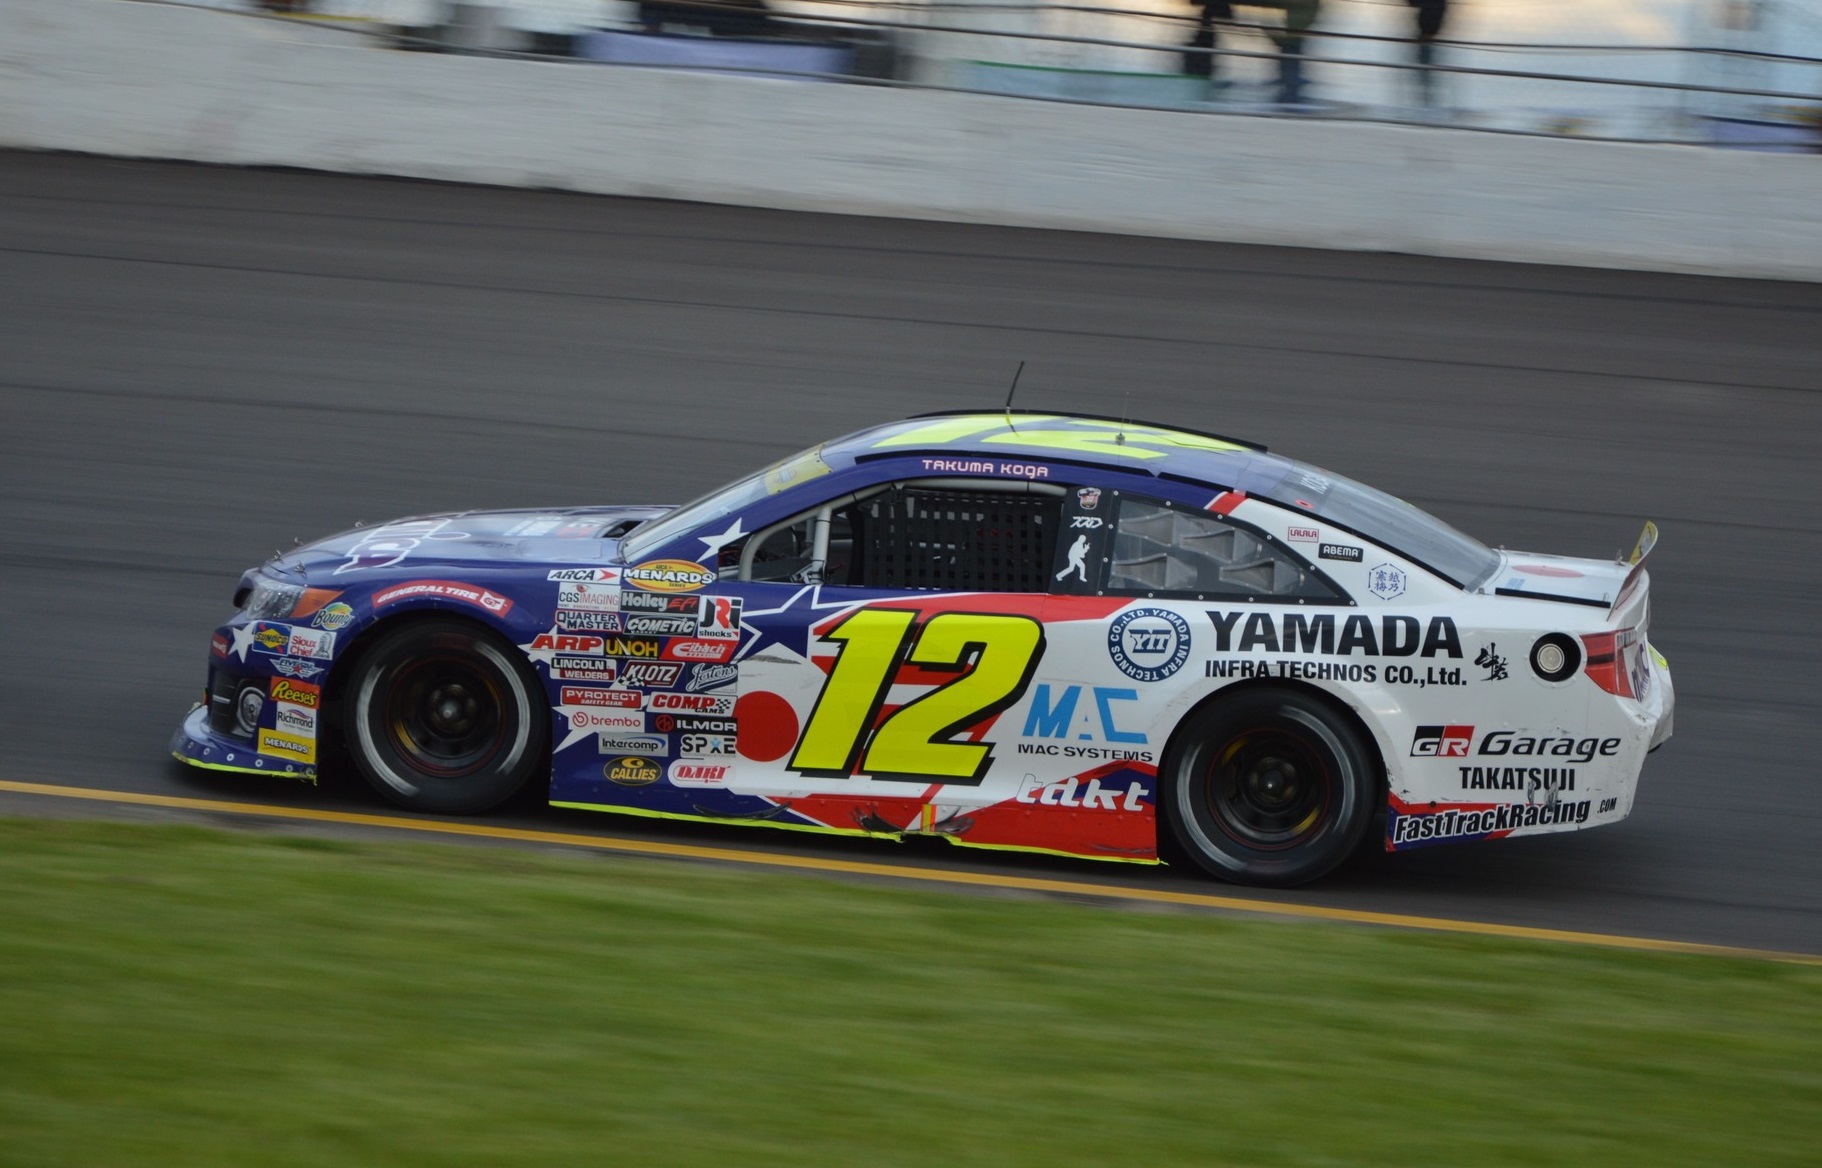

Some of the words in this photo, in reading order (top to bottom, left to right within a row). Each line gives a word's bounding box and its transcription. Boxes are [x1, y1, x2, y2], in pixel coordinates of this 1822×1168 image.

[922, 459, 994, 474] TAKUMA
[1001, 463, 1049, 479] KOGA
[1323, 545, 1359, 558] ABEMA
[550, 570, 596, 581] ARCA
[623, 568, 715, 585] MENARDS
[377, 585, 448, 604] GENERAL
[446, 587, 480, 600] TIRE
[622, 592, 669, 612] Holley
[557, 611, 617, 624] QUARTER
[567, 619, 619, 631] MASTER
[627, 616, 695, 634] COMETIC
[1152, 609, 1189, 642] YAMADA
[255, 631, 288, 645] SUNOCO
[292, 635, 316, 648] Sioux
[699, 630, 732, 638] shocks
[1205, 611, 1464, 659] YAMADA
[531, 635, 602, 651] ARP
[606, 638, 659, 657] UNOH
[672, 642, 727, 658] Eibach
[290, 645, 314, 658] Chief
[553, 659, 605, 670] LINCOLN
[1111, 645, 1159, 681] TECHNOS
[1161, 645, 1189, 677] INFRA
[565, 669, 609, 680] WELDERS
[626, 664, 678, 681] KLOTZ
[1205, 659, 1270, 678] INFRA
[1277, 660, 1377, 683] TECHNOS
[566, 691, 638, 700] PYROTECT
[653, 694, 716, 709] COMP
[785, 609, 1047, 786] 12
[277, 710, 314, 728] Richmond
[695, 707, 725, 715] CAMS
[1022, 684, 1148, 744] MAC
[591, 715, 641, 728] brembo
[677, 719, 738, 732] ILMOR
[264, 736, 309, 755] MENARDS
[602, 737, 659, 752] Intercomp
[1410, 732, 1475, 757] GR
[1477, 731, 1622, 763] Garage
[1018, 744, 1060, 756] MAC
[1064, 746, 1153, 762] SYSTEMS
[611, 767, 657, 781] CALLIES
[1459, 767, 1576, 791] TAKATSUJI
